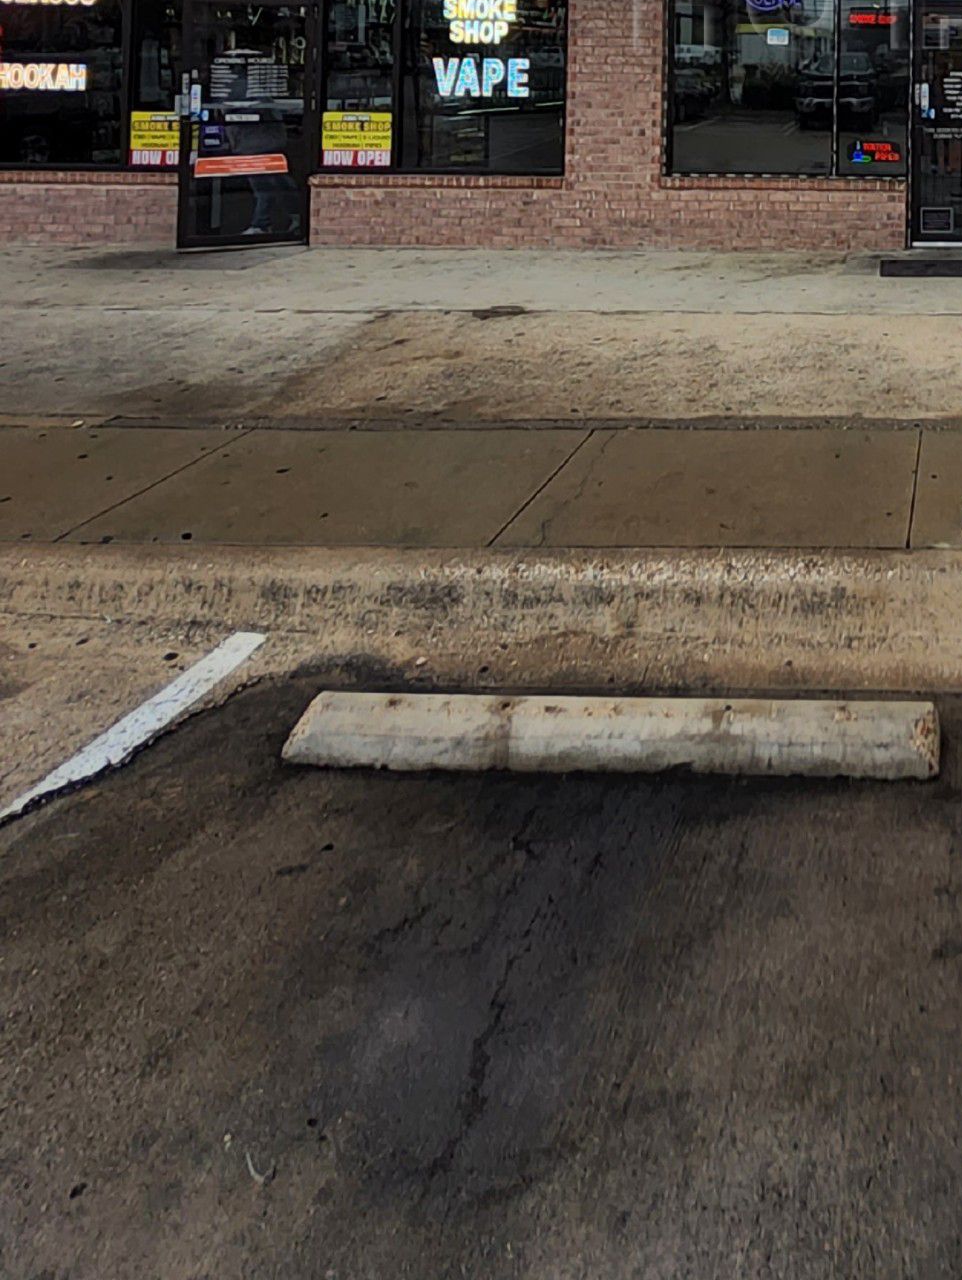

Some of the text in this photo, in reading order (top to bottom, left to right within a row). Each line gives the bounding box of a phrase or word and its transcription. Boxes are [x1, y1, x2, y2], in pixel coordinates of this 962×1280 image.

[449, 20, 509, 45] SHOP
[432, 57, 530, 97] VAPE
[324, 121, 390, 131] SMOKE SHOP
[132, 150, 162, 165] NOW
[323, 150, 390, 166] NOW OPEN
